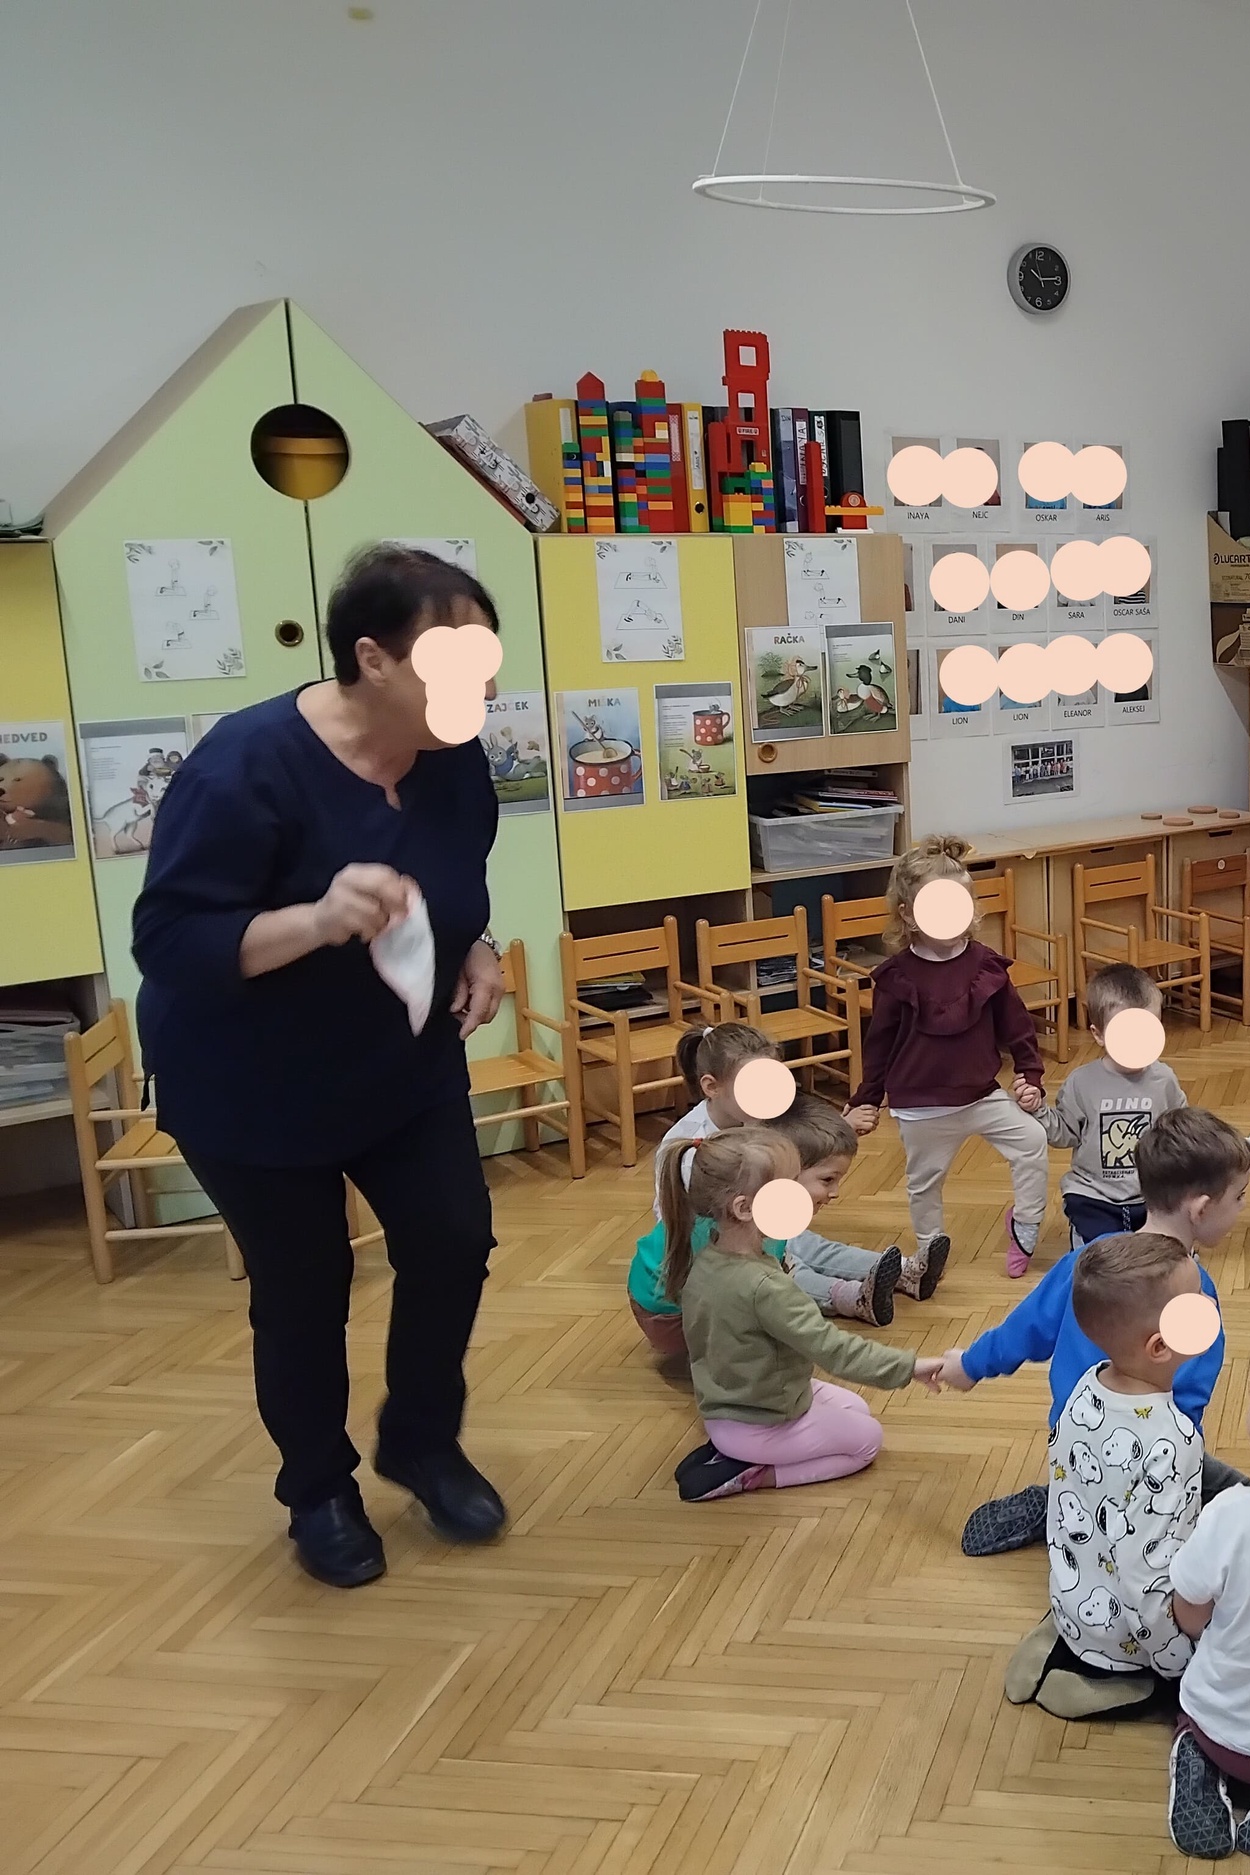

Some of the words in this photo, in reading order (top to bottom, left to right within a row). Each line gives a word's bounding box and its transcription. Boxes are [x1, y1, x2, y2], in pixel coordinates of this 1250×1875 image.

[1035, 250, 1044, 261] 12
[1035, 297, 1042, 307] 6
[907, 511, 930, 520] INAYA
[1035, 513, 1058, 522] OSKAR
[1095, 513, 1110, 522] ARIS
[1012, 613, 1025, 621] DIN
[1067, 611, 1085, 620] SARA
[1113, 608, 1134, 617] OSCAR
[948, 616, 966, 624] DANI
[773, 632, 805, 645] RAČKA
[1012, 713, 1029, 721] LION
[1063, 709, 1092, 718] ELEANOR
[951, 717, 969, 725] LION
[1100, 1098, 1152, 1110] DINO
